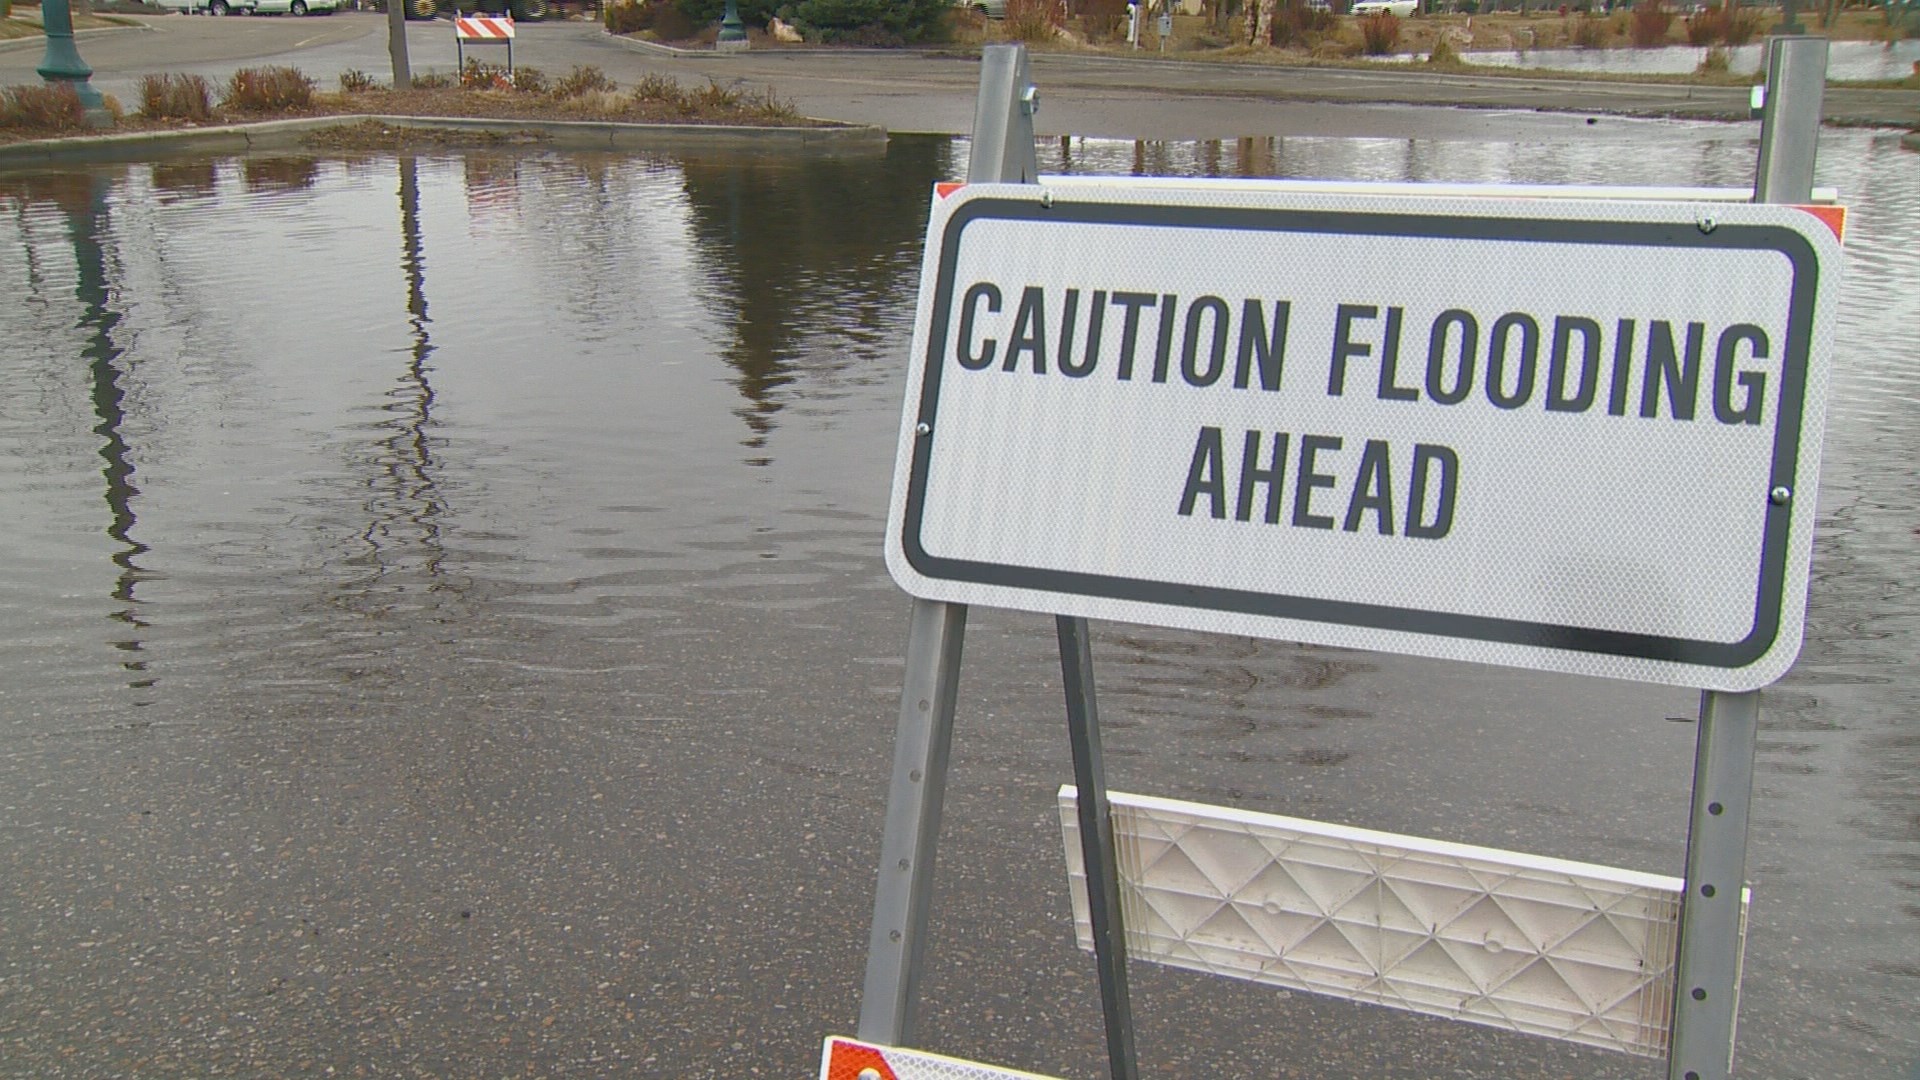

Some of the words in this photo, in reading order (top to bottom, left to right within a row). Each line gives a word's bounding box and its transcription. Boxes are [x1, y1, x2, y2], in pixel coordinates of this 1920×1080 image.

[957, 283, 1290, 391] CAUTION
[1328, 304, 1769, 425] FLOODING
[1178, 426, 1458, 539] AHEAD
